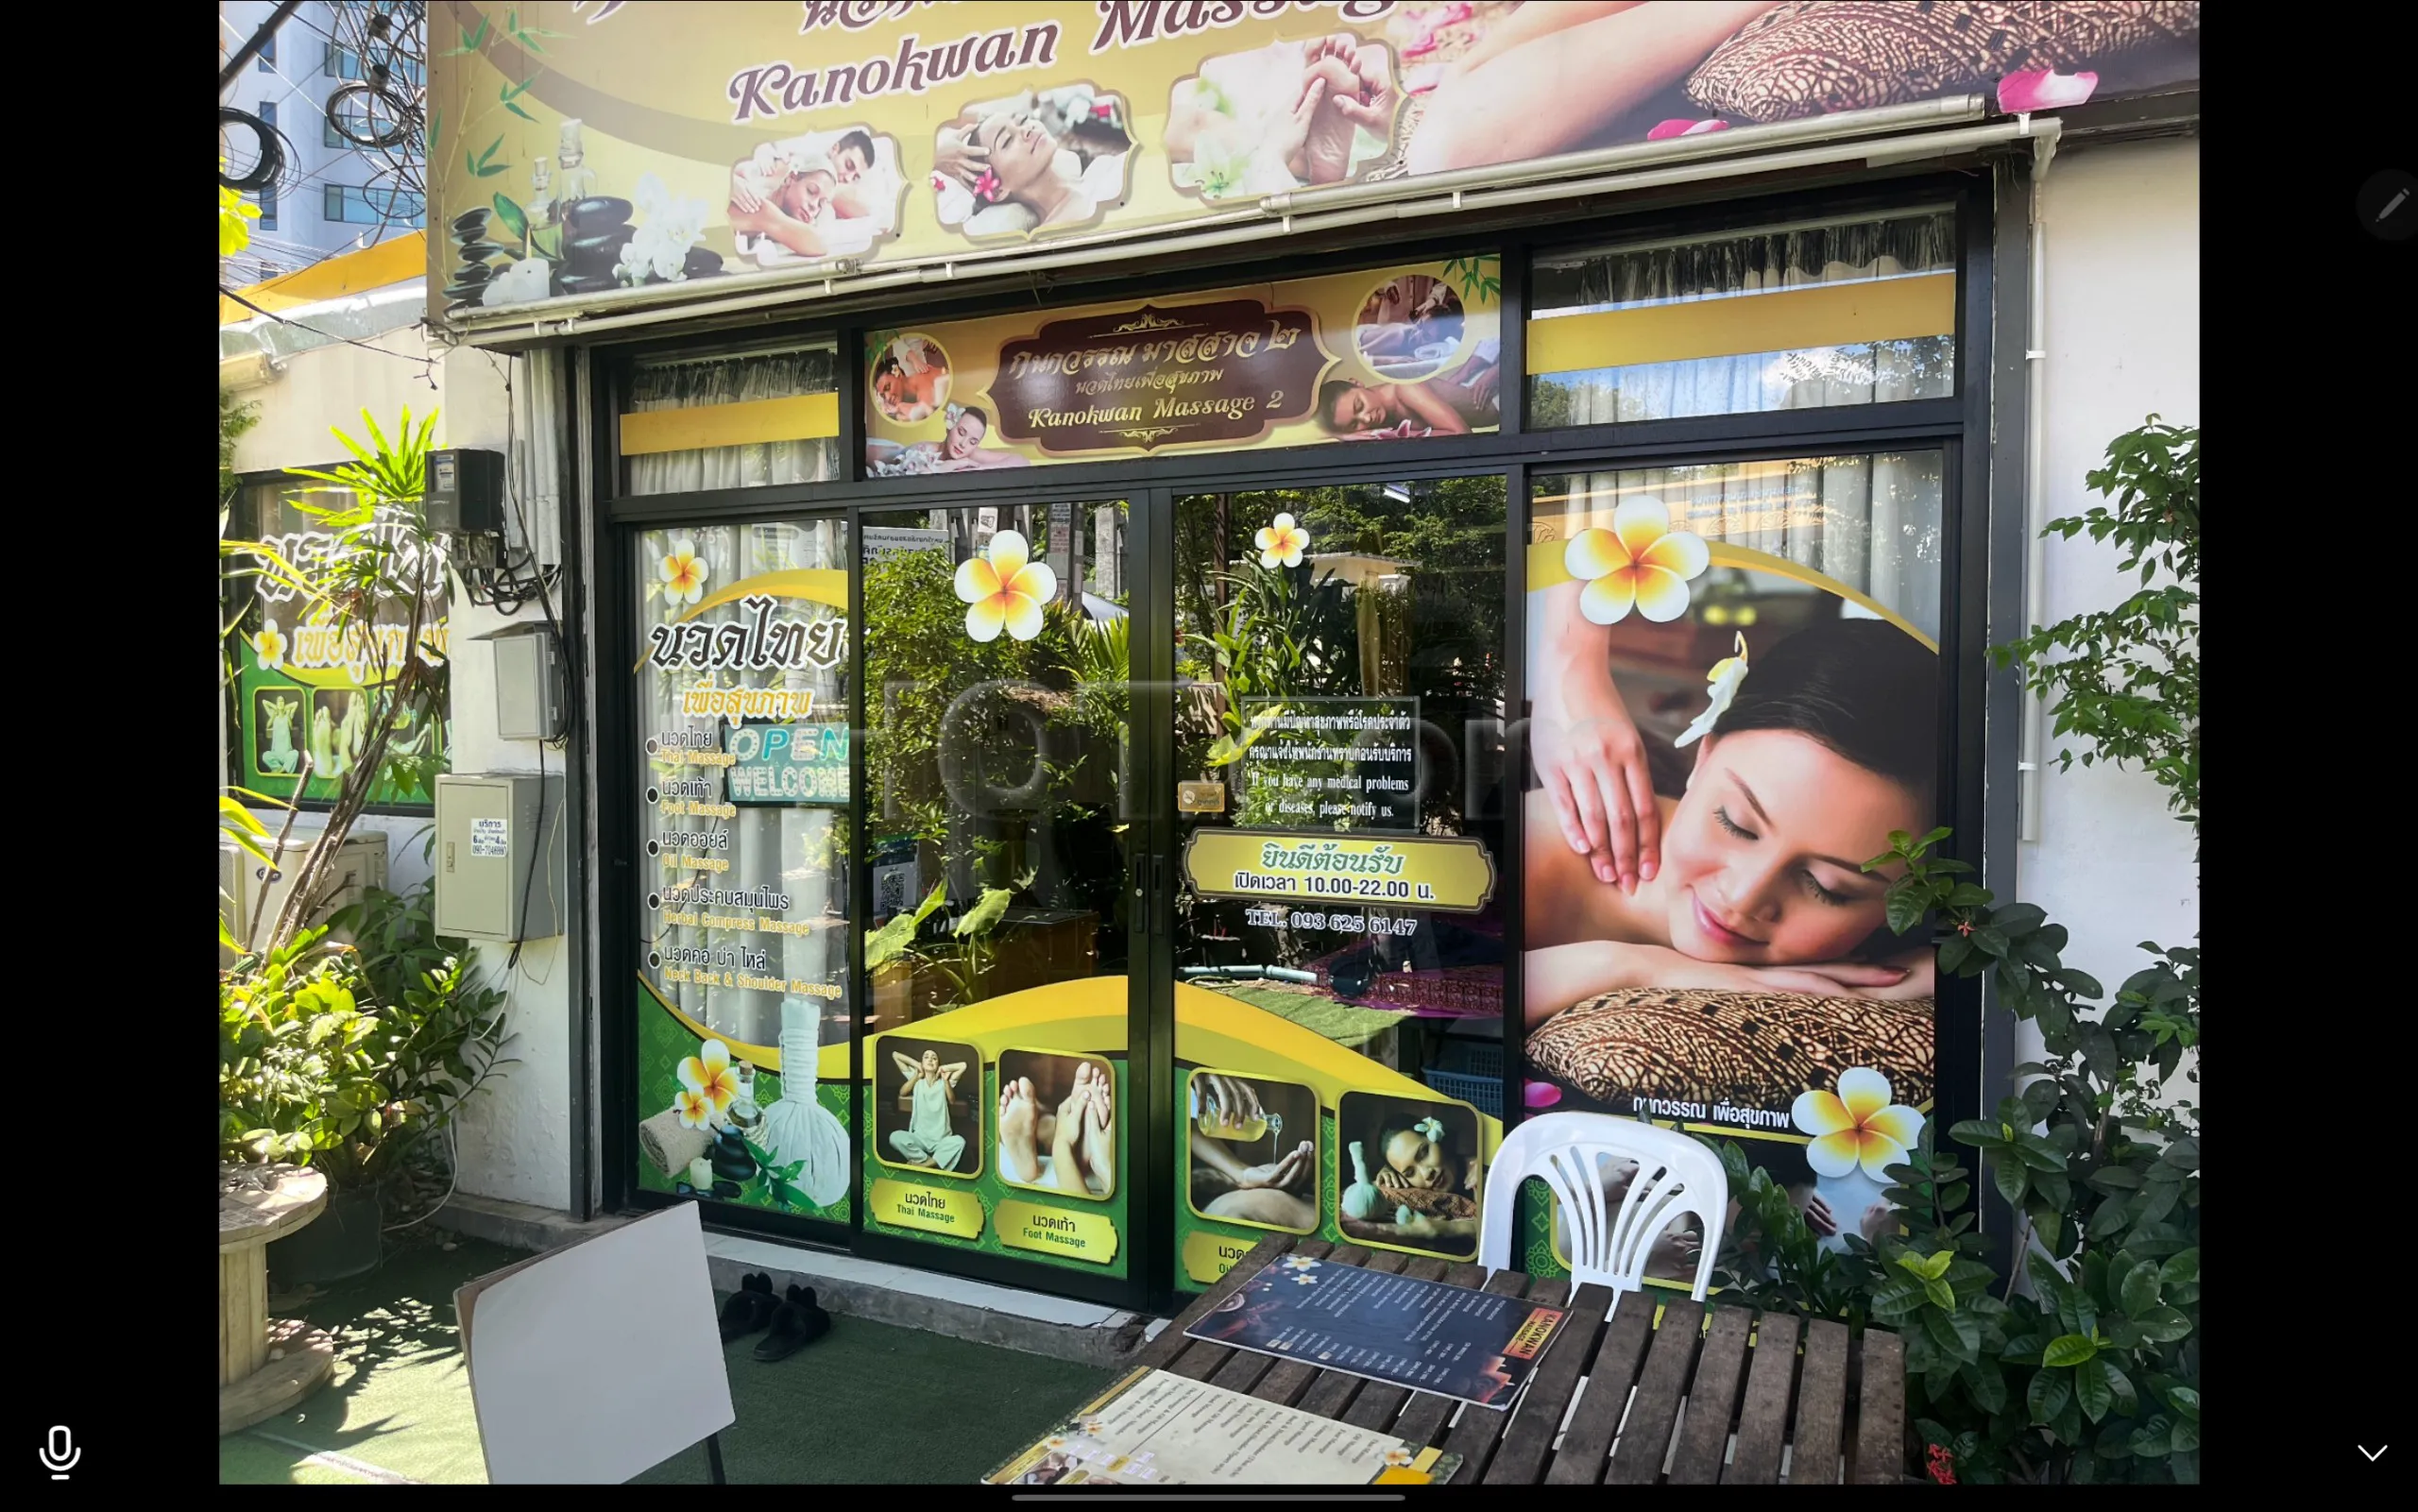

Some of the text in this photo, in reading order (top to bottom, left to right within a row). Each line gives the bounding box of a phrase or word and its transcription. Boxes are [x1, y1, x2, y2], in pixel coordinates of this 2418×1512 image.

[731, 23, 1060, 122] Kanokwan
[1075, 366, 1226, 396] นวดไทยเพื่อสุขภาพ
[1027, 389, 1286, 430] Kanokwan Massage 2
[649, 594, 847, 670] นวดไทย
[682, 672, 813, 726] เพื่อสุขภาพ
[661, 725, 713, 747] นวดไทย
[728, 727, 849, 761] OPEN
[660, 749, 736, 767] Thai Massage
[661, 778, 712, 798] นวดเท้า
[729, 766, 849, 798] WELCOME
[1264, 774, 1279, 788] you
[1283, 773, 1303, 787] have
[1307, 776, 1323, 790] any
[1327, 775, 1362, 790] medical
[1366, 775, 1410, 792] problems
[479, 819, 502, 828] บริการ
[661, 802, 737, 820] Foot Massage
[1265, 803, 1275, 812] or
[1320, 802, 1348, 818] please
[1350, 802, 1377, 820] notify
[1381, 805, 1394, 816] us.
[662, 828, 728, 850] นวดออยล์
[662, 855, 729, 875] Oil Massage
[1261, 841, 1405, 875] ยินดีต้อนรับ
[1235, 873, 1436, 899] เปิดเวลา 10.00-22.00 น.
[662, 886, 790, 913] นวดประคบสมุนไพร
[664, 912, 809, 935] Herbal Compress Massage
[1245, 909, 1417, 936] TEL. 093 625 6147
[664, 946, 766, 971] นวดคอ บ่า ไหล่
[664, 968, 843, 999] Neck Back & Shoulder Massage
[1712, 1096, 1791, 1130] เพื่อสุขภาพ
[904, 1191, 945, 1210] นวดไทย
[896, 1204, 955, 1225] Thai Massage
[1032, 1211, 1076, 1232] นวดเท้า
[1023, 1228, 1086, 1249] Foot Massage
[1519, 1313, 1557, 1353] KANOKWAN
